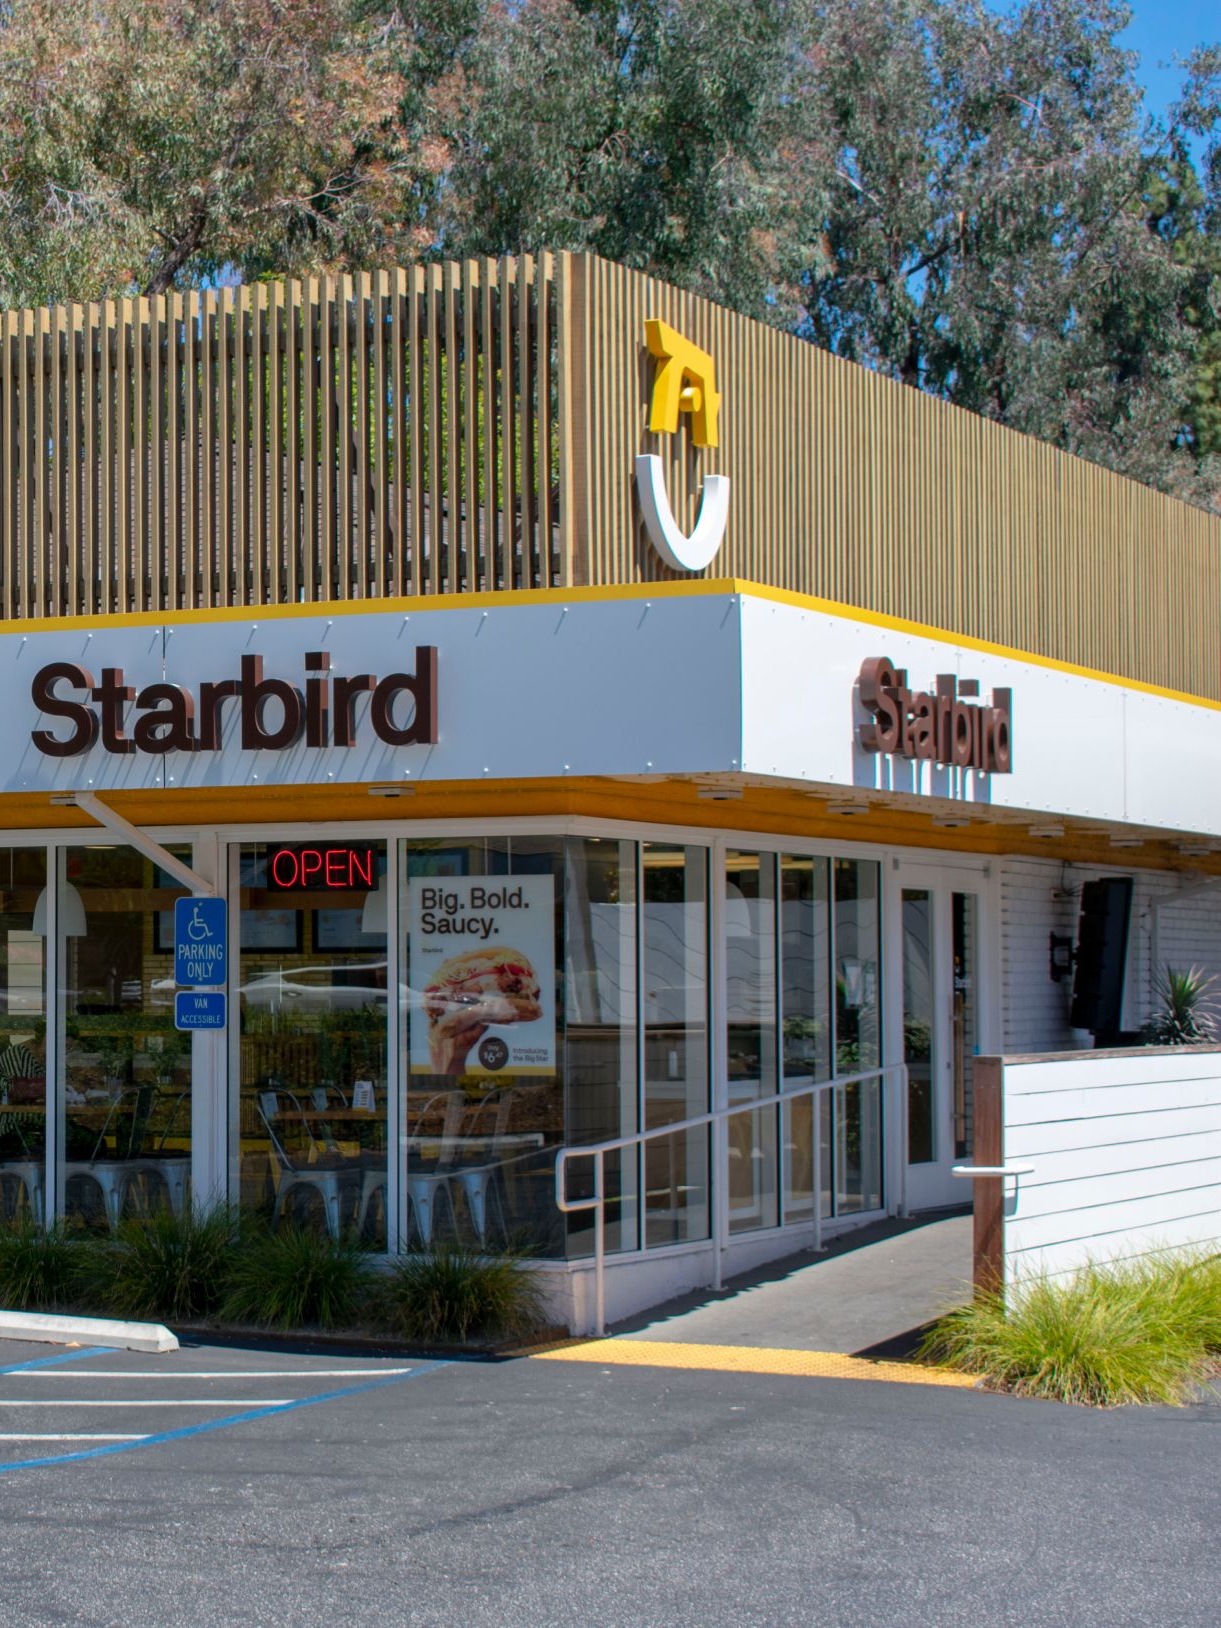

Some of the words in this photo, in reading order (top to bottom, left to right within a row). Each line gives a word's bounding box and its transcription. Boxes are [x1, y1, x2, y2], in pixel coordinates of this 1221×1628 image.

[31, 645, 438, 758] Starbird
[857, 656, 1013, 774] Starbird
[273, 849, 372, 887] OPEN
[421, 887, 465, 915] Big.
[470, 886, 530, 909] Bold.
[421, 912, 499, 940] Saucy.
[179, 944, 223, 960] PARKING
[187, 962, 214, 978] ONLY
[194, 998, 208, 1008] VAN
[181, 1014, 221, 1024] ACCESSIBLE
[512, 1047, 548, 1056] Introducing
